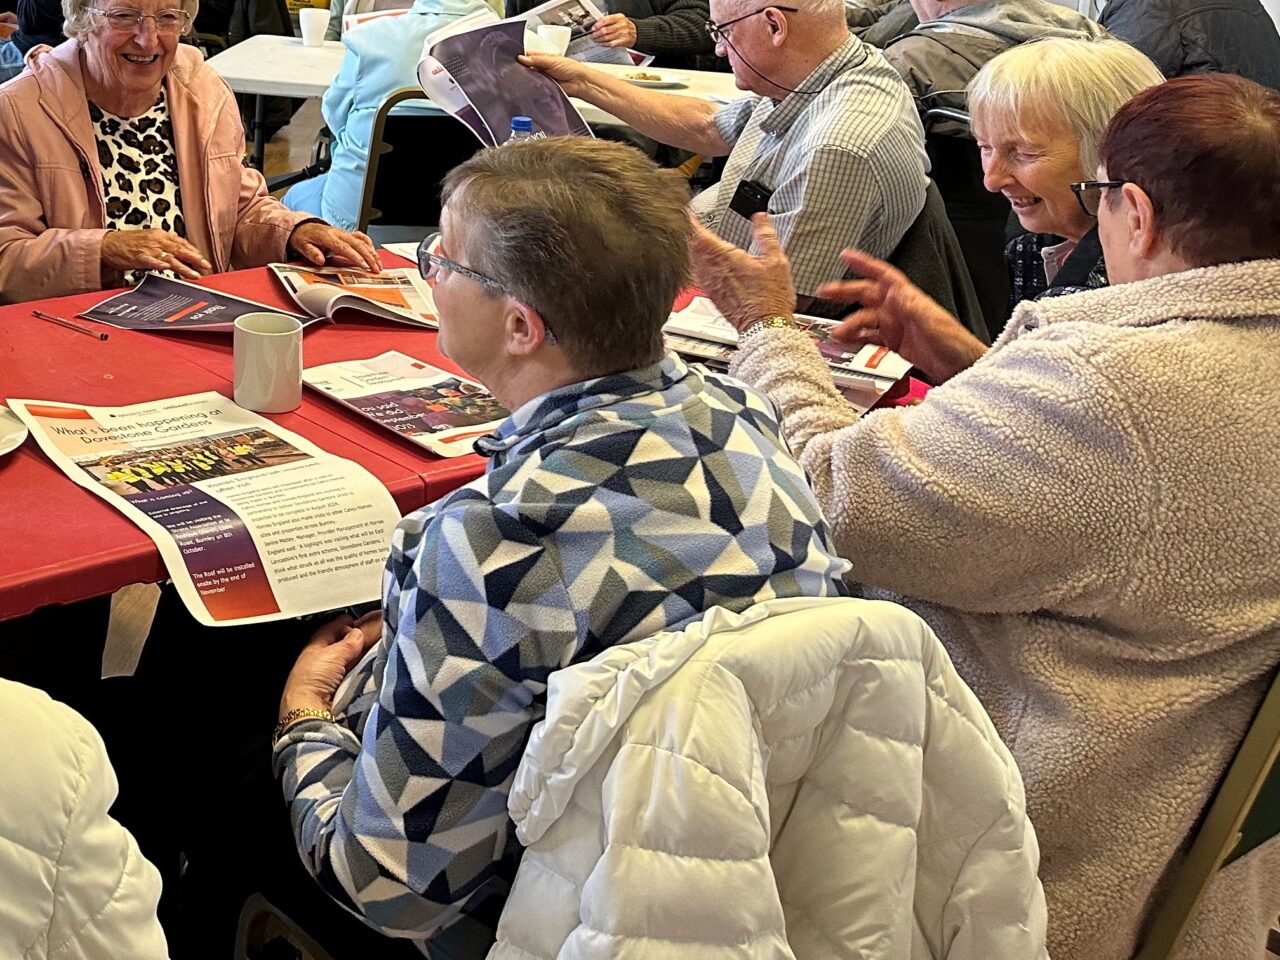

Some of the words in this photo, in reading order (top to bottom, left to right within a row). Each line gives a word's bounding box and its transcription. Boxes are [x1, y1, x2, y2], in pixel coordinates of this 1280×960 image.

[50, 425, 97, 436] What's
[97, 425, 136, 434] been
[136, 411, 209, 428] happening
[209, 408, 223, 416] at
[80, 430, 152, 444] Dovestone
[154, 420, 212, 433] Gardens
[233, 562, 255, 571] installed
[277, 574, 299, 583] produced
[334, 562, 359, 571] atmosphere
